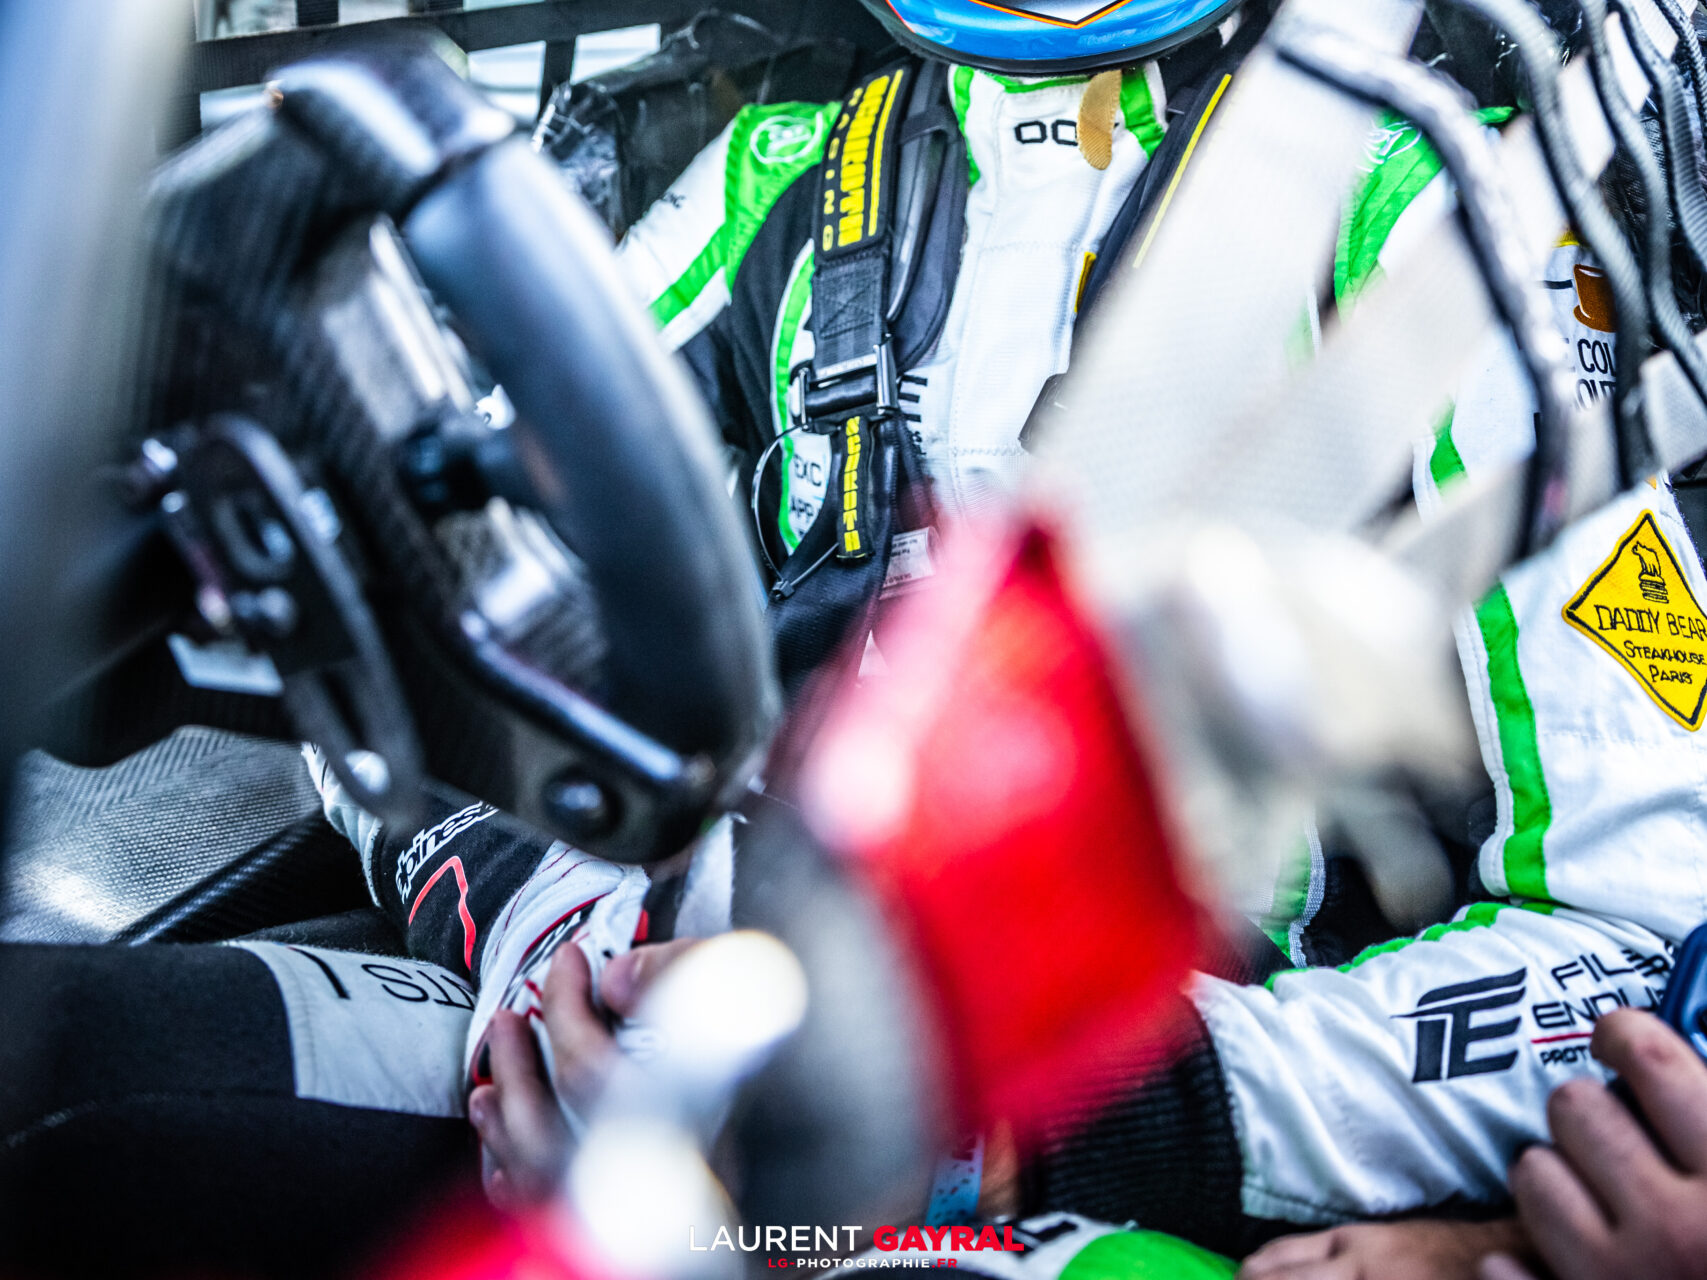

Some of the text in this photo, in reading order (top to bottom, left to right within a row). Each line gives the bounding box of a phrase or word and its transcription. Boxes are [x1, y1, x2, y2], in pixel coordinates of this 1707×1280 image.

[1594, 604, 1707, 641] DADDY BEAR
[1649, 664, 1693, 685] PARIS
